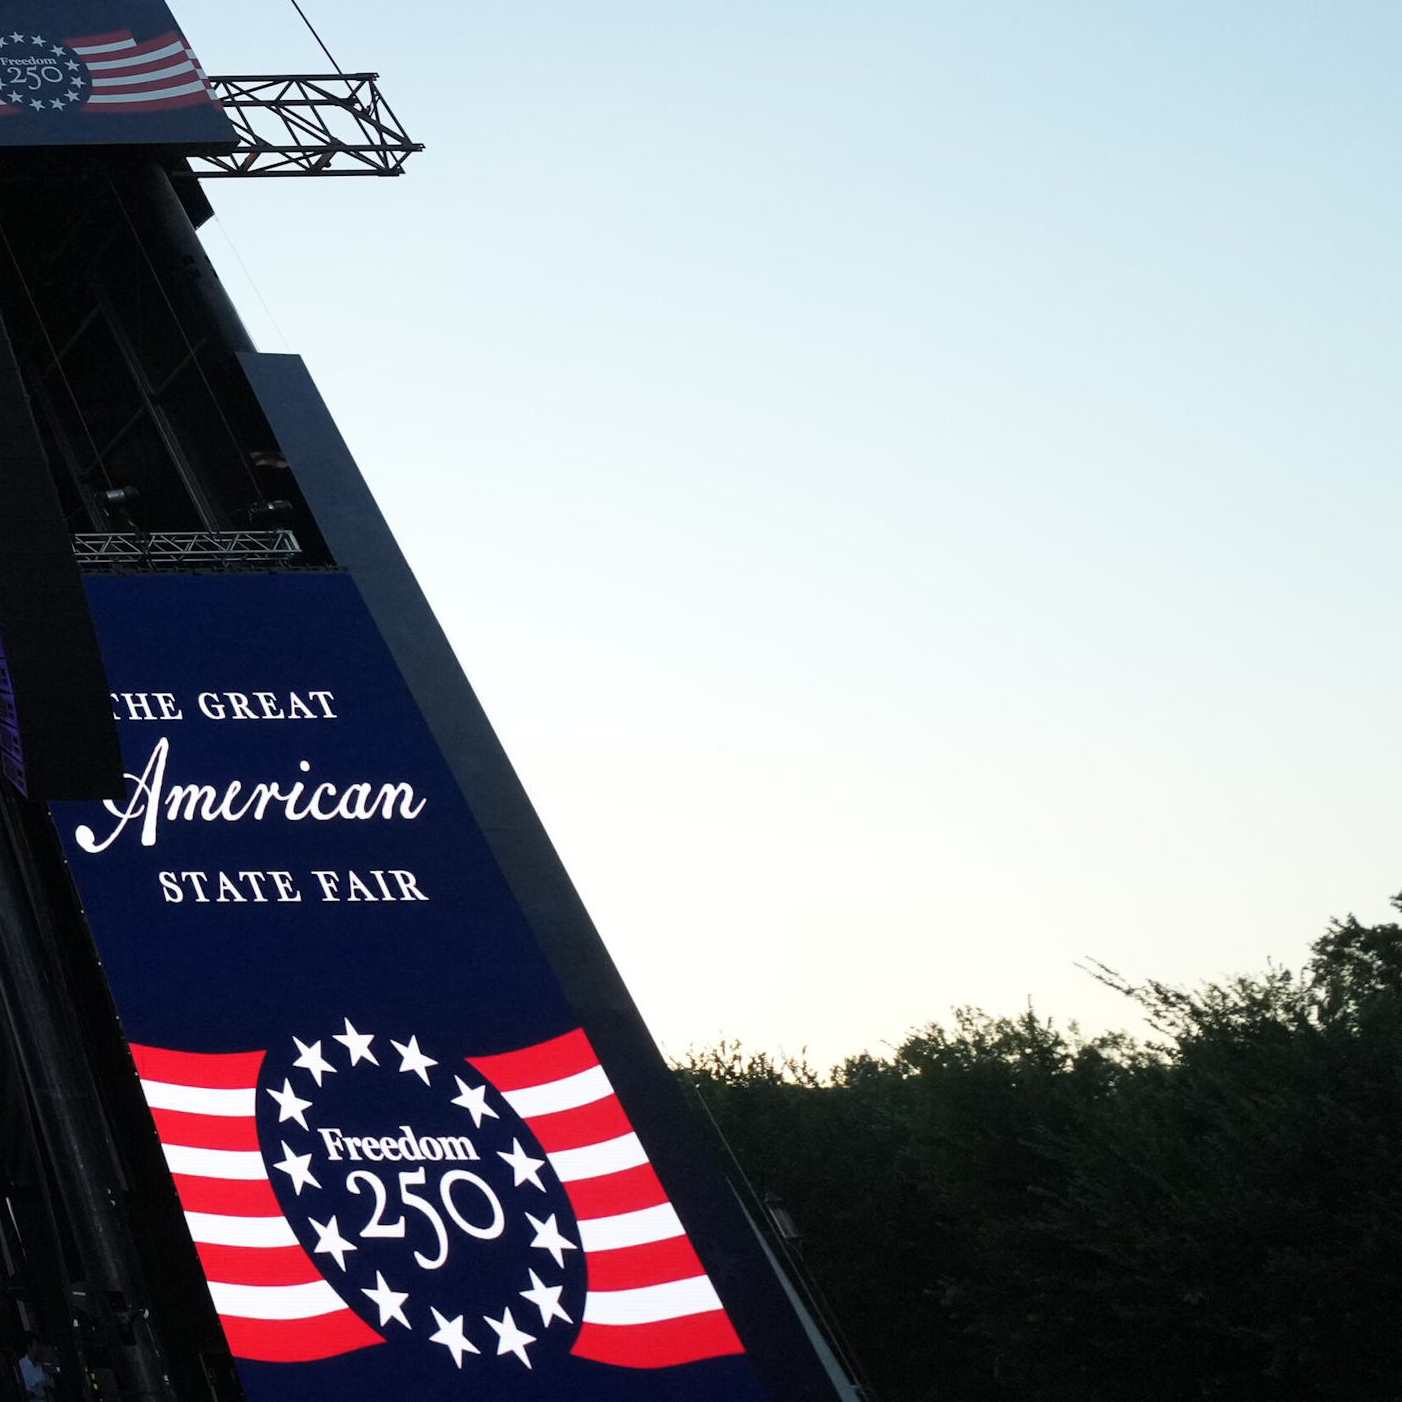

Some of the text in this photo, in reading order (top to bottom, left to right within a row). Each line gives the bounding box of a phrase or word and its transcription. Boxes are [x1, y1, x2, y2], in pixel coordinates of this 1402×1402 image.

[0, 56, 57, 66] Freedom
[7, 66, 63, 90] 250
[198, 691, 338, 720] GREAT
[75, 736, 427, 854] American
[158, 869, 430, 903] STATE FAIR
[317, 1125, 481, 1161] Freedom
[346, 1166, 505, 1270] 250
